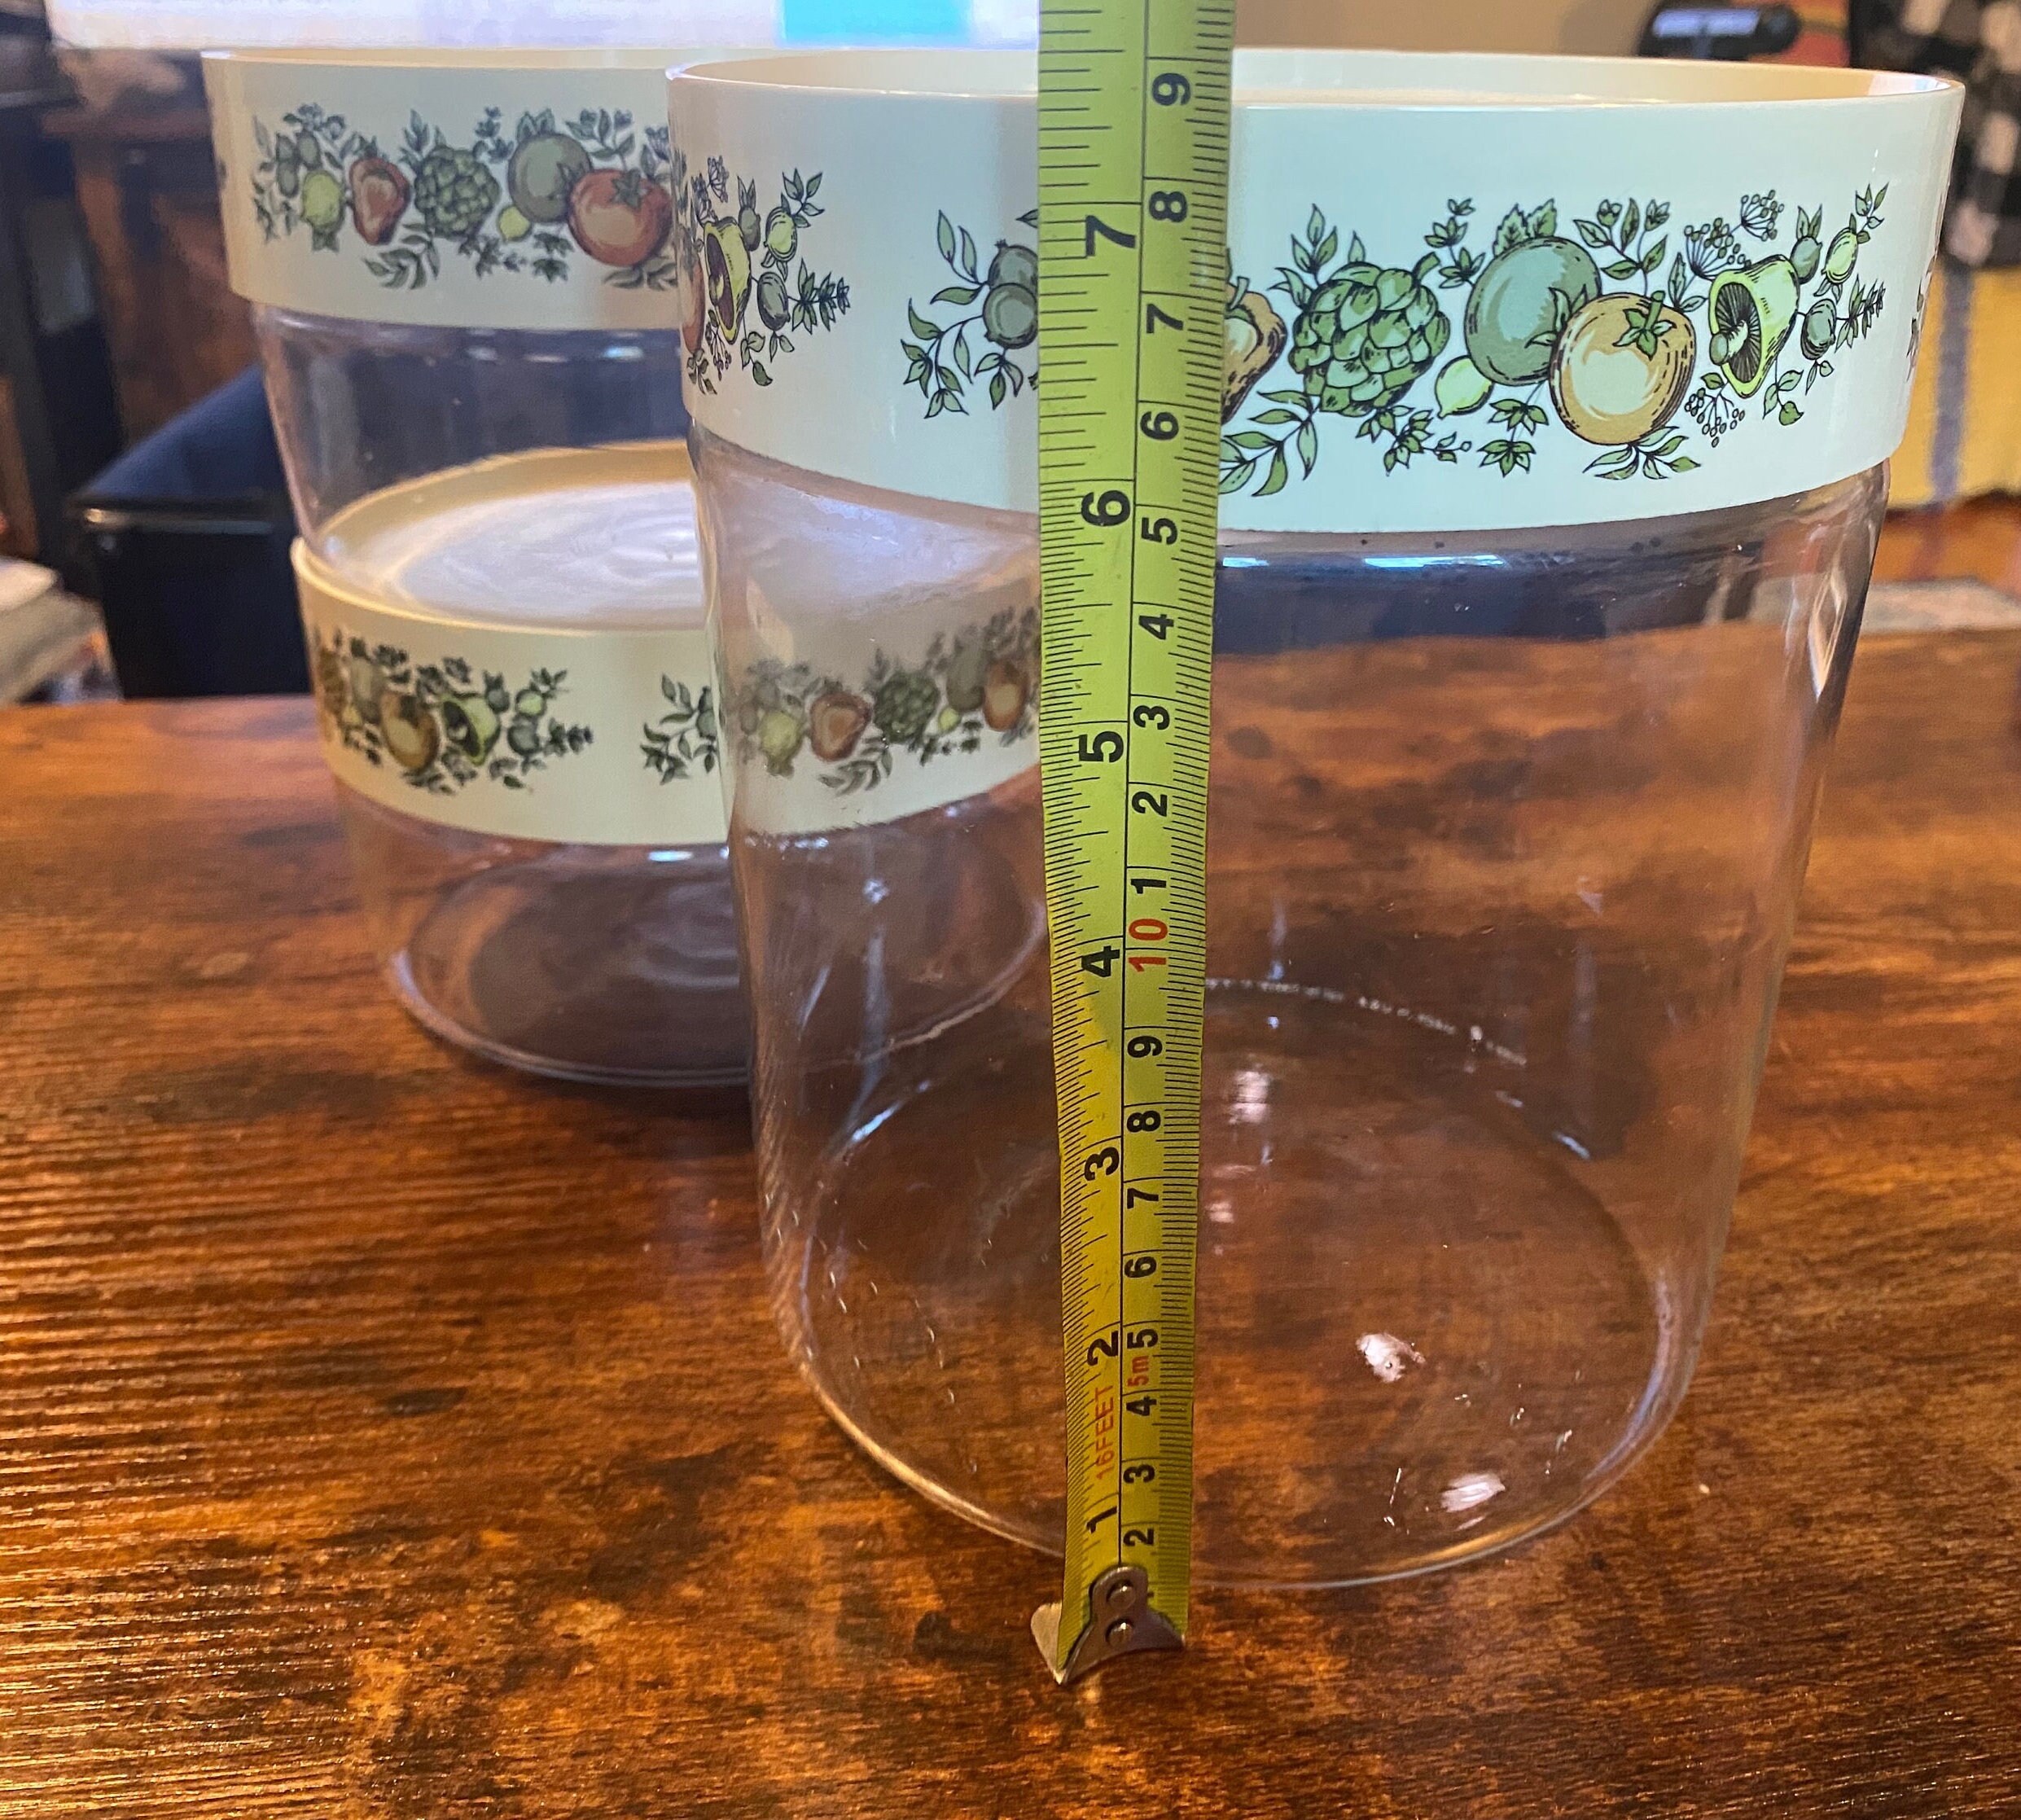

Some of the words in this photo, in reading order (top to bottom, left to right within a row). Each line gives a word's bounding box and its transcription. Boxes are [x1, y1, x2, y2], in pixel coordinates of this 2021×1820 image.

[1151, 72, 1190, 106] 9
[1148, 191, 1188, 222] 8
[1085, 215, 1136, 257] 7
[1146, 303, 1184, 334] 7
[1140, 411, 1179, 440] 6
[1081, 490, 1130, 526] 6
[1141, 517, 1177, 545] 5
[1139, 614, 1174, 639] 4
[1133, 705, 1170, 730] 3
[1079, 731, 1124, 763] 5
[1132, 792, 1168, 817] 2
[1131, 879, 1167, 894] 1
[1081, 946, 1120, 977] 4
[1127, 1036, 1163, 1058] 9
[1127, 1111, 1161, 1133] 8
[1084, 1147, 1120, 1182] 3
[1126, 1187, 1159, 1208] 7
[1124, 1256, 1156, 1278] 6
[1087, 1331, 1119, 1366] 2
[1127, 1328, 1158, 1348] 5
[1127, 1356, 1149, 1387] 5m
[1126, 1396, 1157, 1416] 4
[1123, 1464, 1155, 1484] 3
[1086, 1506, 1117, 1534] 1
[1124, 1528, 1154, 1547] 2
